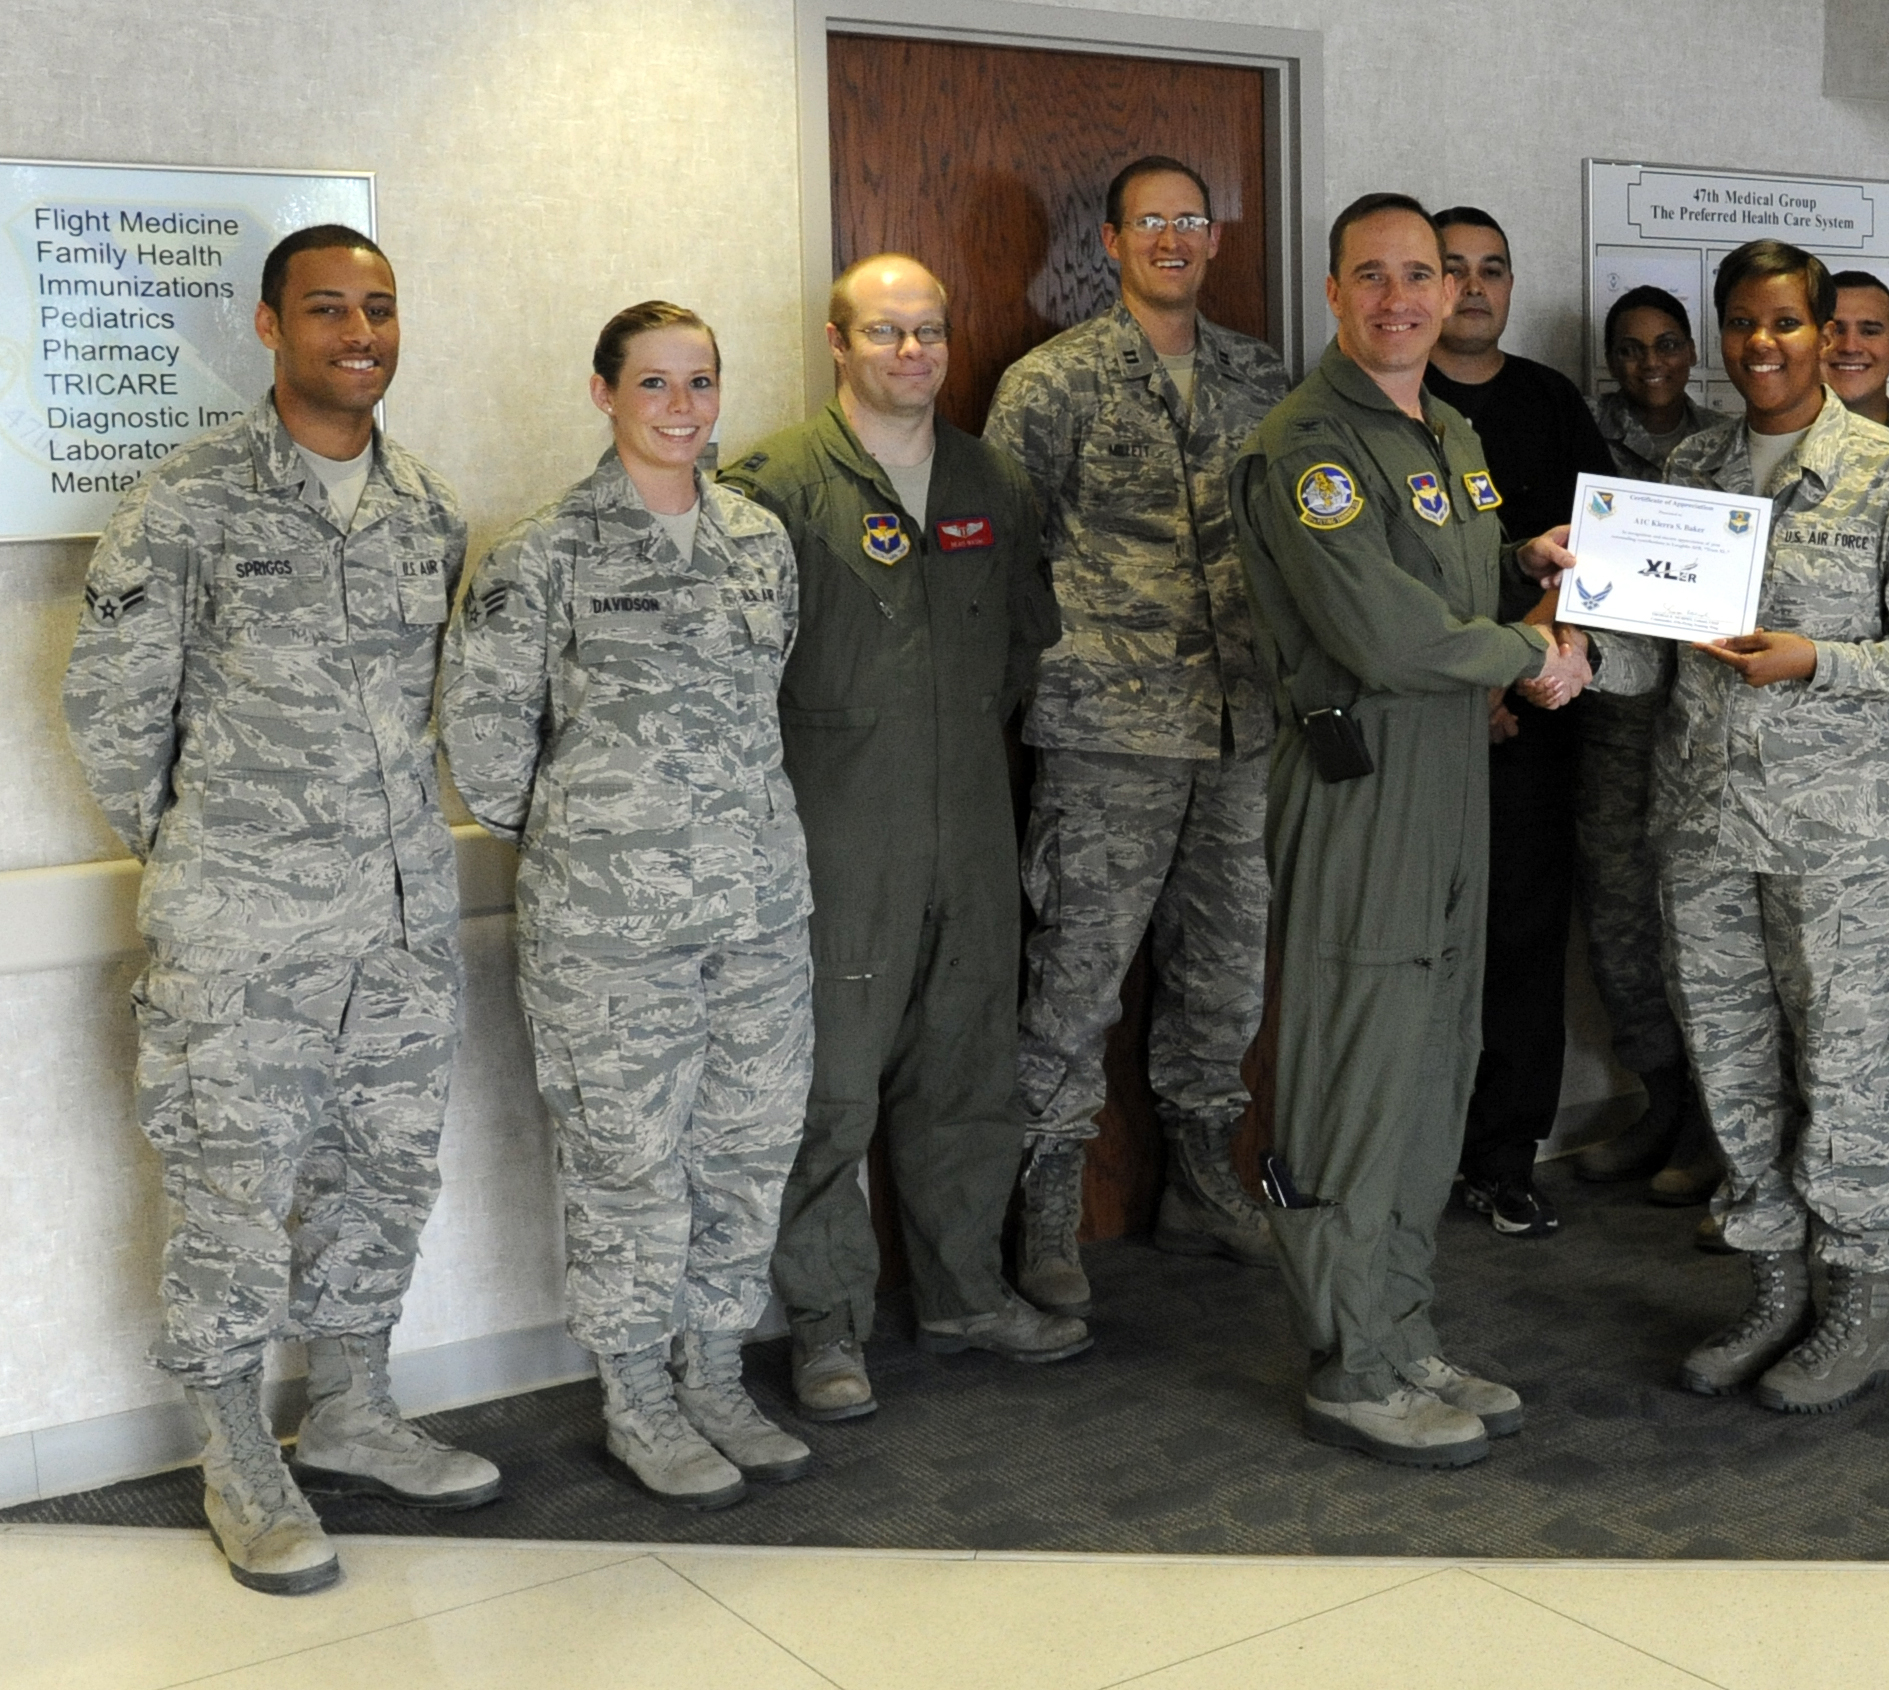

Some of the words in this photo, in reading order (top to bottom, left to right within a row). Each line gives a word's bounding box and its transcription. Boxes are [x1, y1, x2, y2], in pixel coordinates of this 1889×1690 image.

[1693, 189, 1720, 203] 47th
[1725, 190, 1774, 207] Medical
[1779, 193, 1817, 211] Group
[34, 207, 111, 237] Flight
[119, 211, 239, 237] Medicine
[1651, 205, 1676, 220] The
[1680, 206, 1737, 224] Preferred
[1742, 209, 1780, 226] Health
[1784, 211, 1812, 228] Care
[1815, 214, 1855, 232] System
[36, 241, 127, 270] Family
[137, 243, 223, 267] Health
[39, 273, 235, 299] Immunizations
[41, 306, 175, 330] Pediatrics
[43, 338, 180, 367] Pharmacy
[44, 373, 178, 396] TRICARE
[47, 406, 189, 434] Diagnostic
[199, 406, 245, 428] Im
[49, 440, 181, 462] Laborato
[52, 470, 141, 494] Menta
[1808, 531, 1829, 546] AIR
[1834, 533, 1870, 550] FORCE
[235, 560, 293, 578] SPRIGGS
[420, 559, 439, 574] AIR
[592, 596, 661, 613] DAVIDSON
